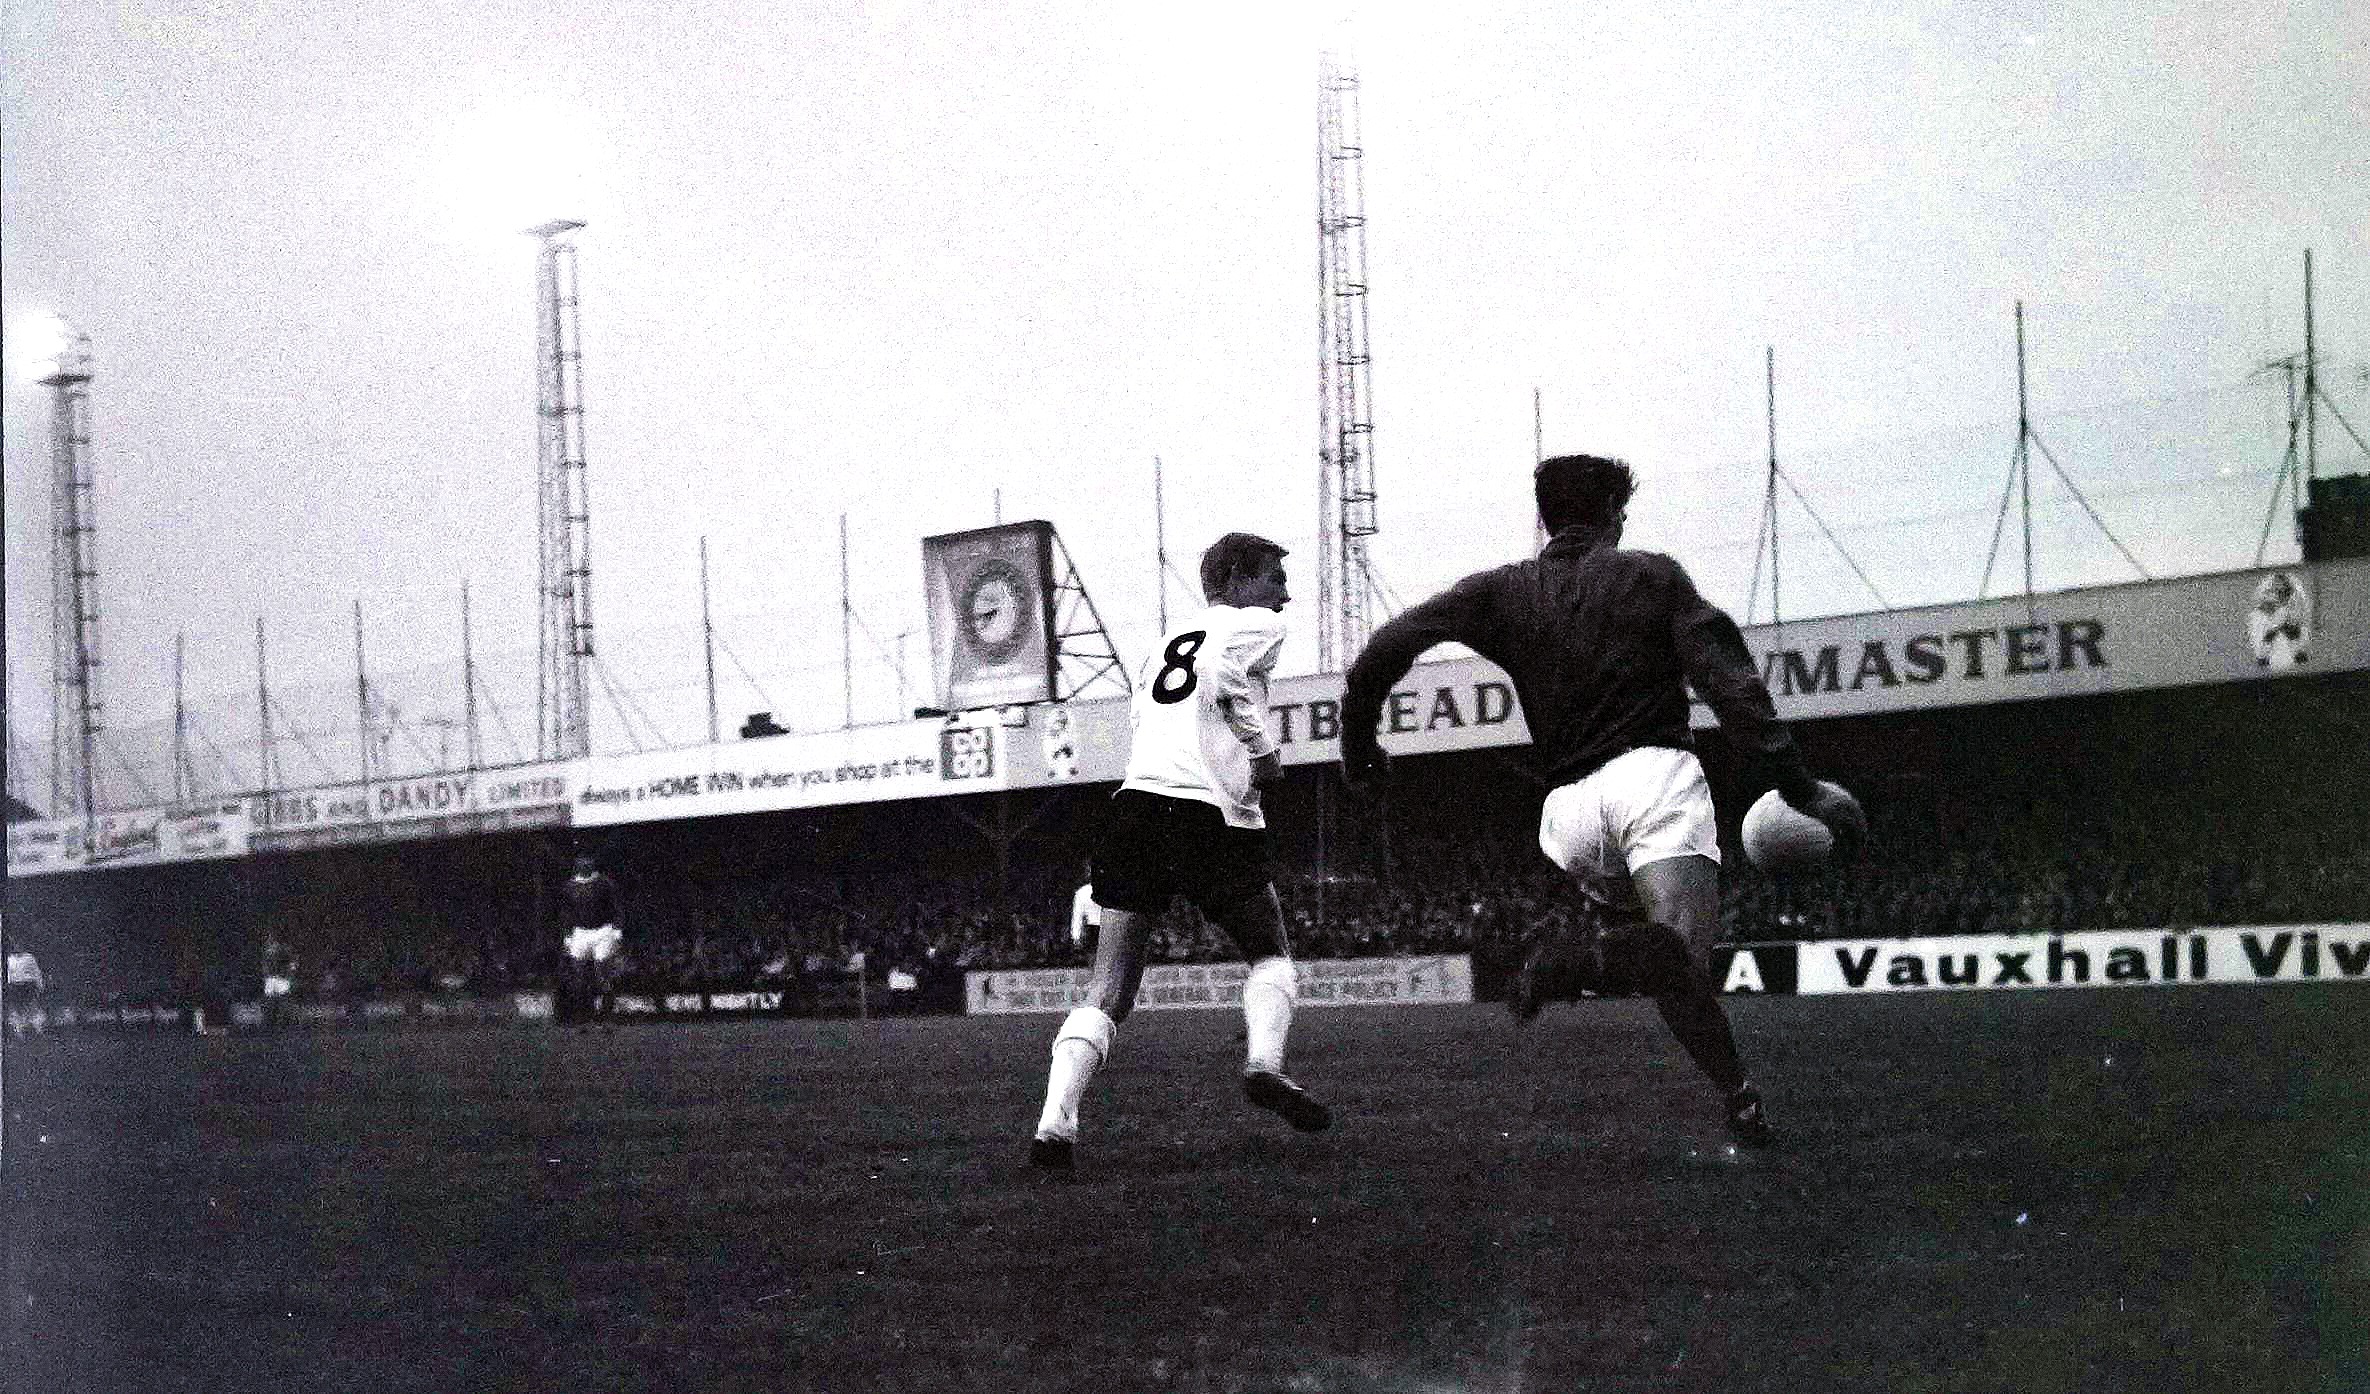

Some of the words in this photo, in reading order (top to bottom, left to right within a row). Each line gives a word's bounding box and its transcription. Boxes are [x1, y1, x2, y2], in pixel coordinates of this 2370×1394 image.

[1152, 629, 1207, 705] 8
[379, 780, 470, 815] DANDY
[648, 774, 699, 798] HOME
[705, 771, 743, 792] WIN
[748, 768, 794, 789] when
[801, 769, 830, 792] you
[880, 759, 901, 778] at
[904, 755, 934, 775] the
[1721, 949, 1766, 993] A
[1834, 934, 2210, 989] Vauxhall
[2239, 930, 2370, 977] Viv
